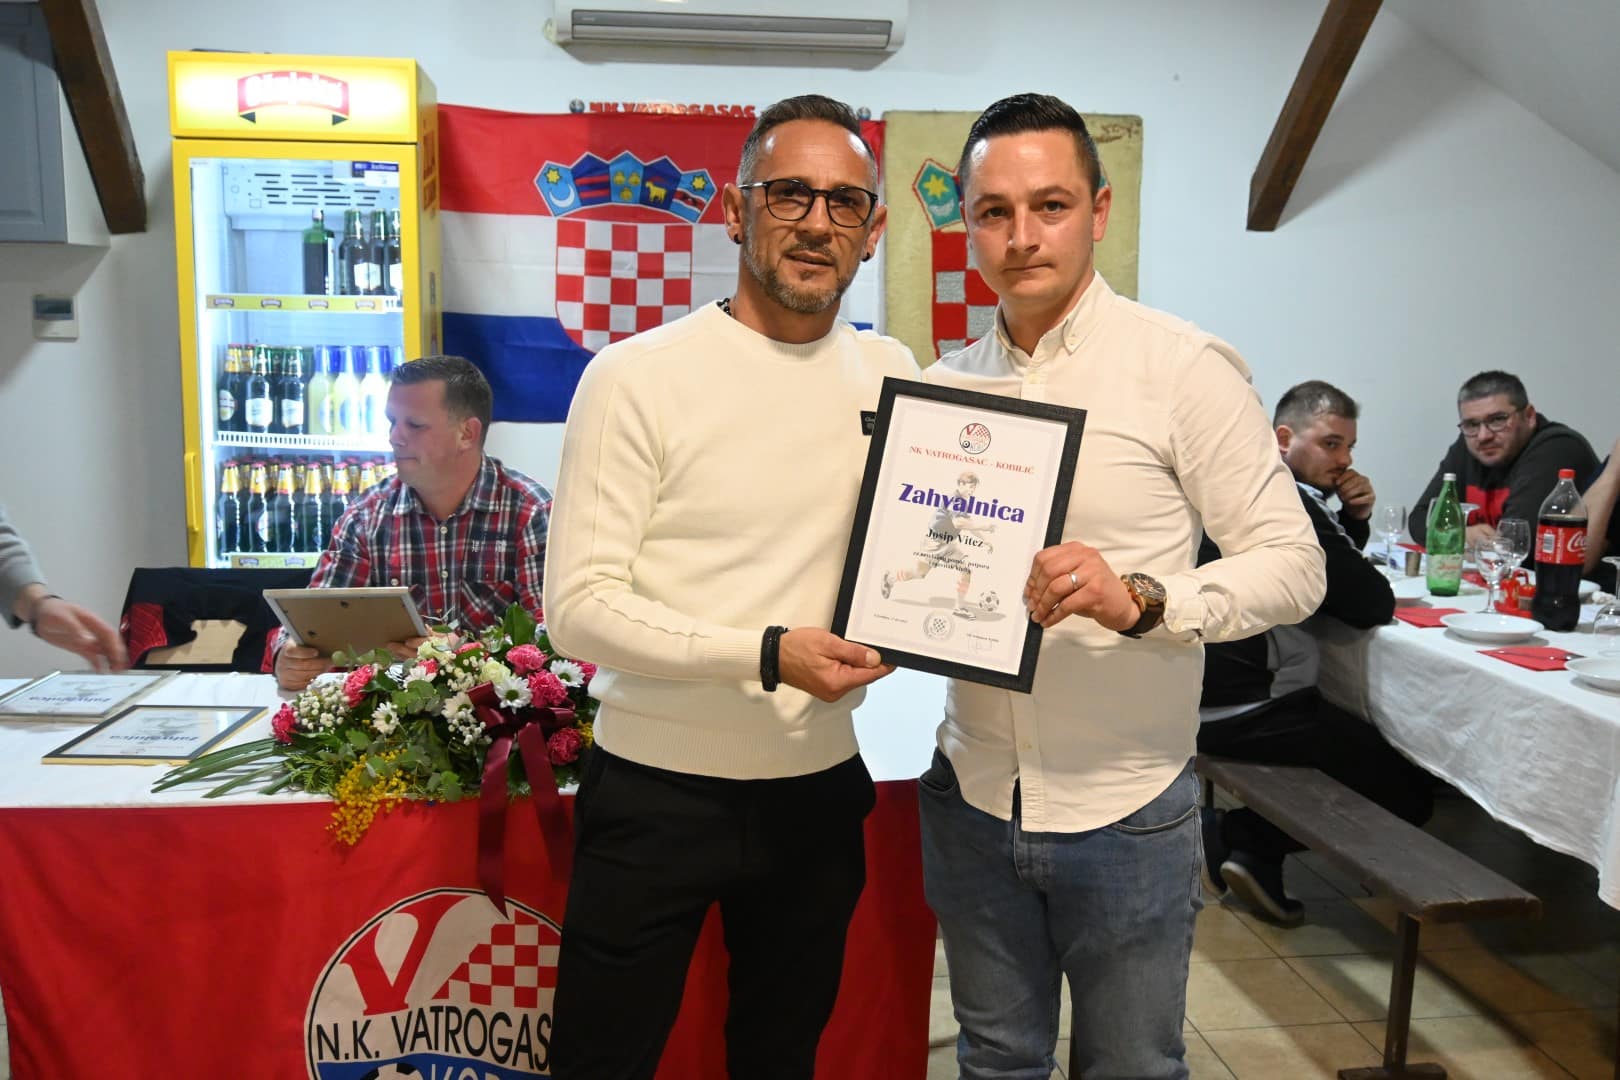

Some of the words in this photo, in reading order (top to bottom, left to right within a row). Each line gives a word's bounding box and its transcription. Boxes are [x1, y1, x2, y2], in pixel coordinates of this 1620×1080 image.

[910, 446, 922, 455] NK
[925, 448, 988, 466] VATROGASAC
[899, 483, 1025, 523] Zahvalnica
[926, 528, 954, 544] Josip
[957, 534, 985, 547] Vitez
[316, 1019, 380, 1060] N.K.
[391, 1005, 551, 1072] VATROGAS
